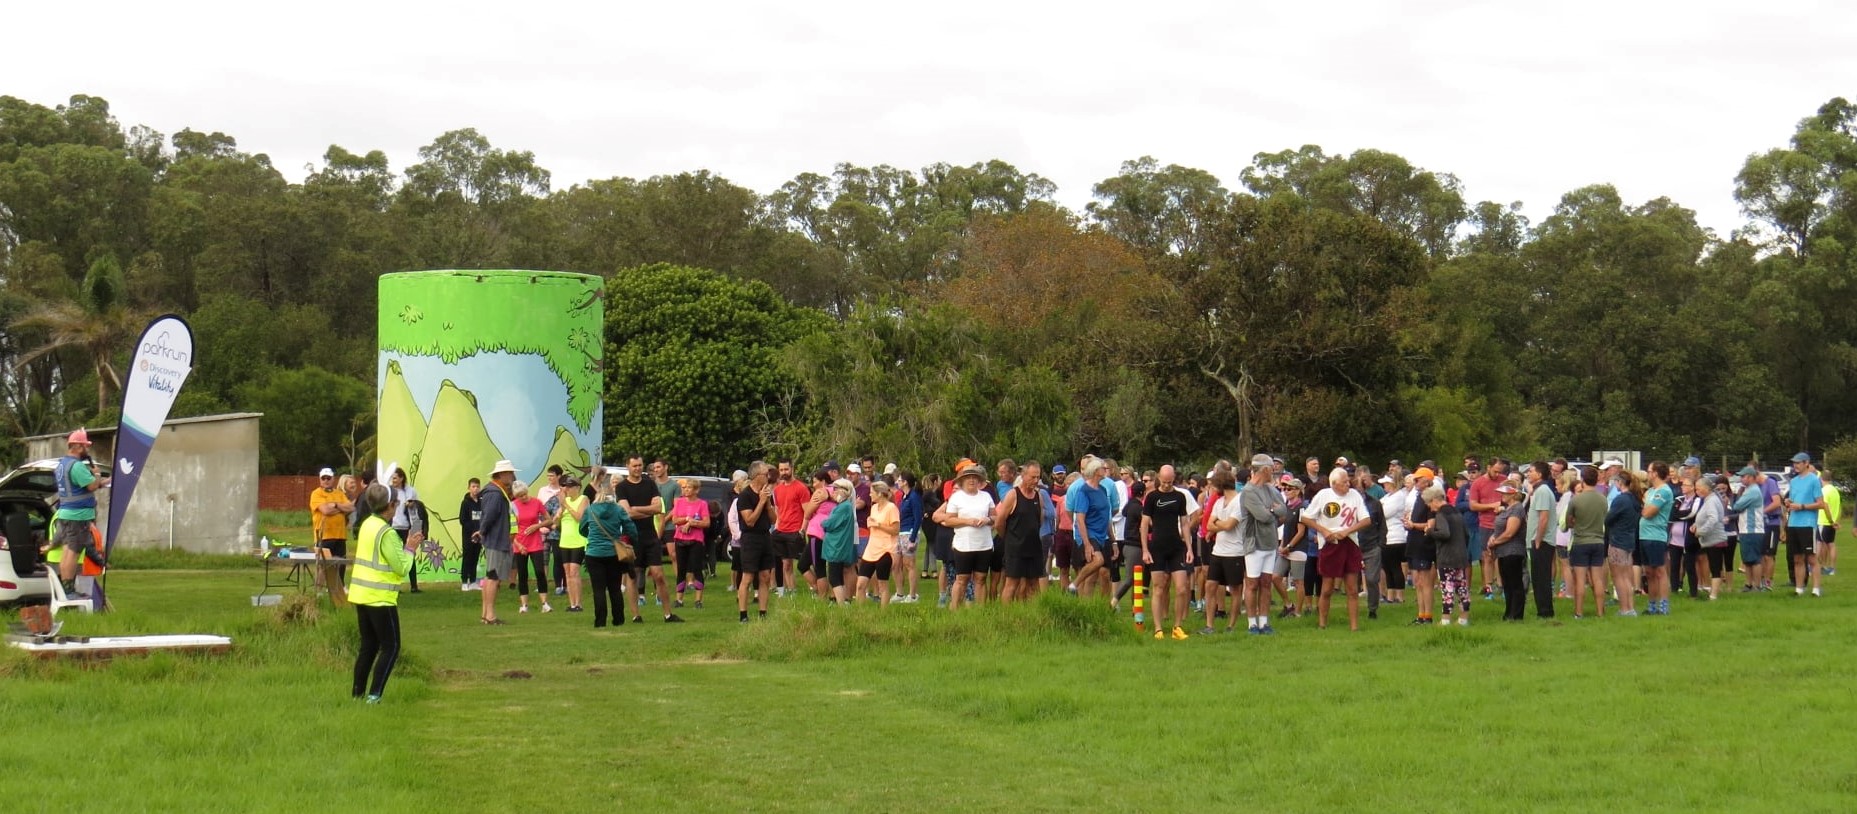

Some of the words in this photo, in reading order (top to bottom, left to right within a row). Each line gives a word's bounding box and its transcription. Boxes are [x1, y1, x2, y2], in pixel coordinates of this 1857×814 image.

[143, 338, 188, 362] parkrun
[150, 362, 182, 379] Discovery
[148, 374, 175, 398] Vitality
